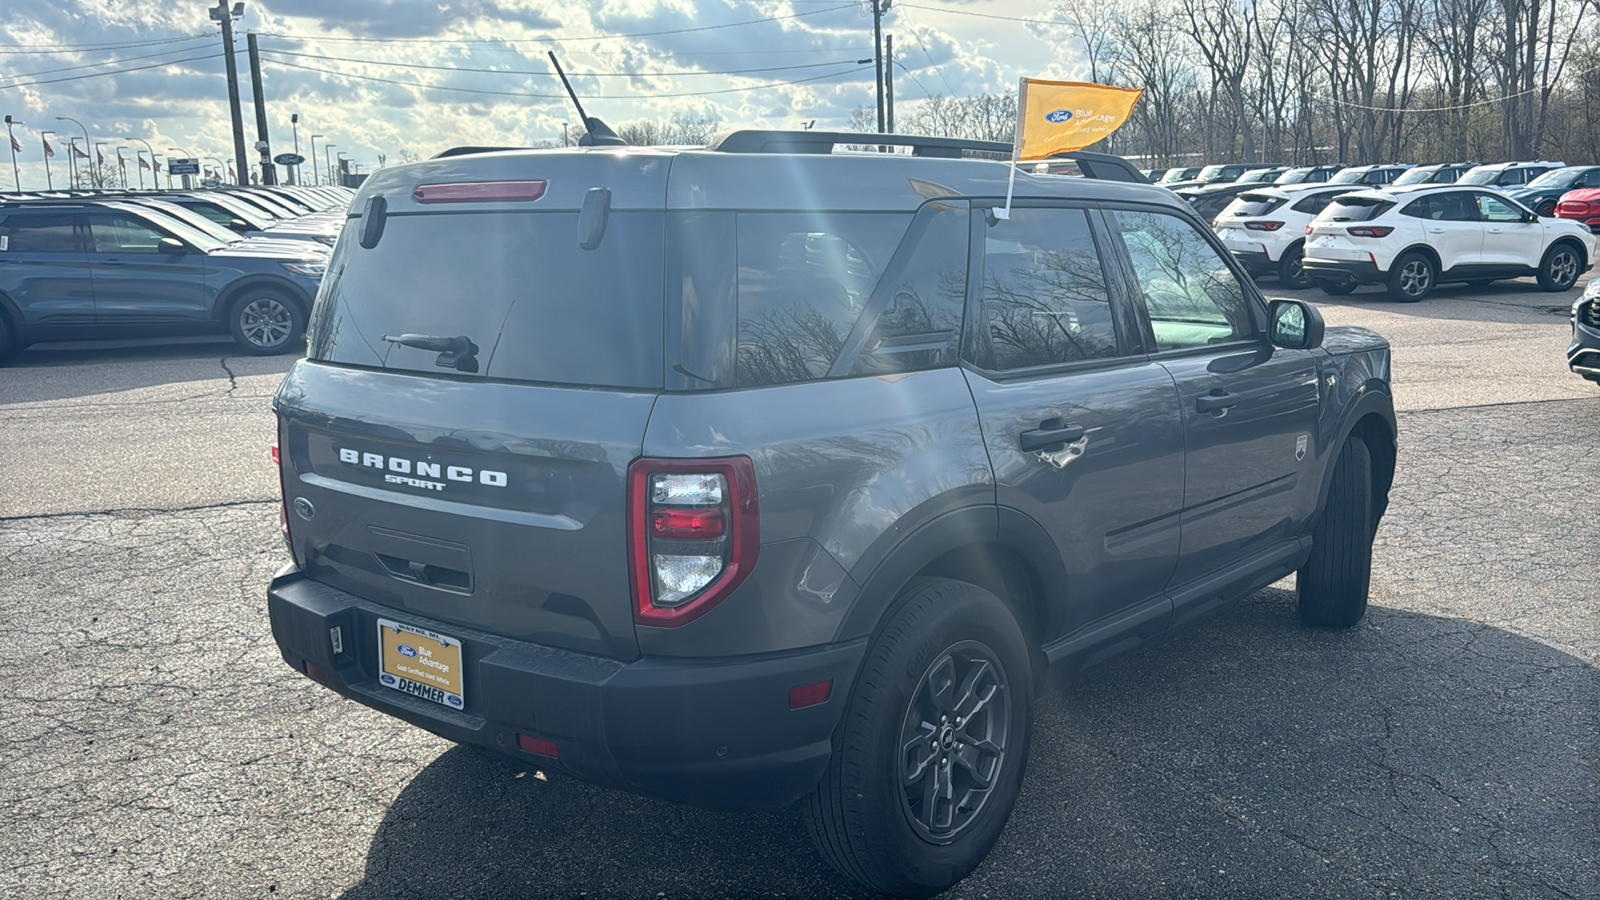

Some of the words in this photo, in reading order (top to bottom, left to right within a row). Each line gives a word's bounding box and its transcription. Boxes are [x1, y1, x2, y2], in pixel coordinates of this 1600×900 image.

[1073, 114, 1115, 126] Adtage
[1075, 109, 1093, 118] Blue
[339, 447, 508, 488] BRONCO
[384, 474, 447, 491] SPORT
[419, 646, 432, 657] Blue
[419, 656, 449, 673] Advantage
[397, 664, 407, 672] Gold
[407, 667, 425, 677] Certified
[425, 671, 435, 680] Used
[435, 676, 450, 685] Vehicle
[398, 677, 445, 703] DEMMER
